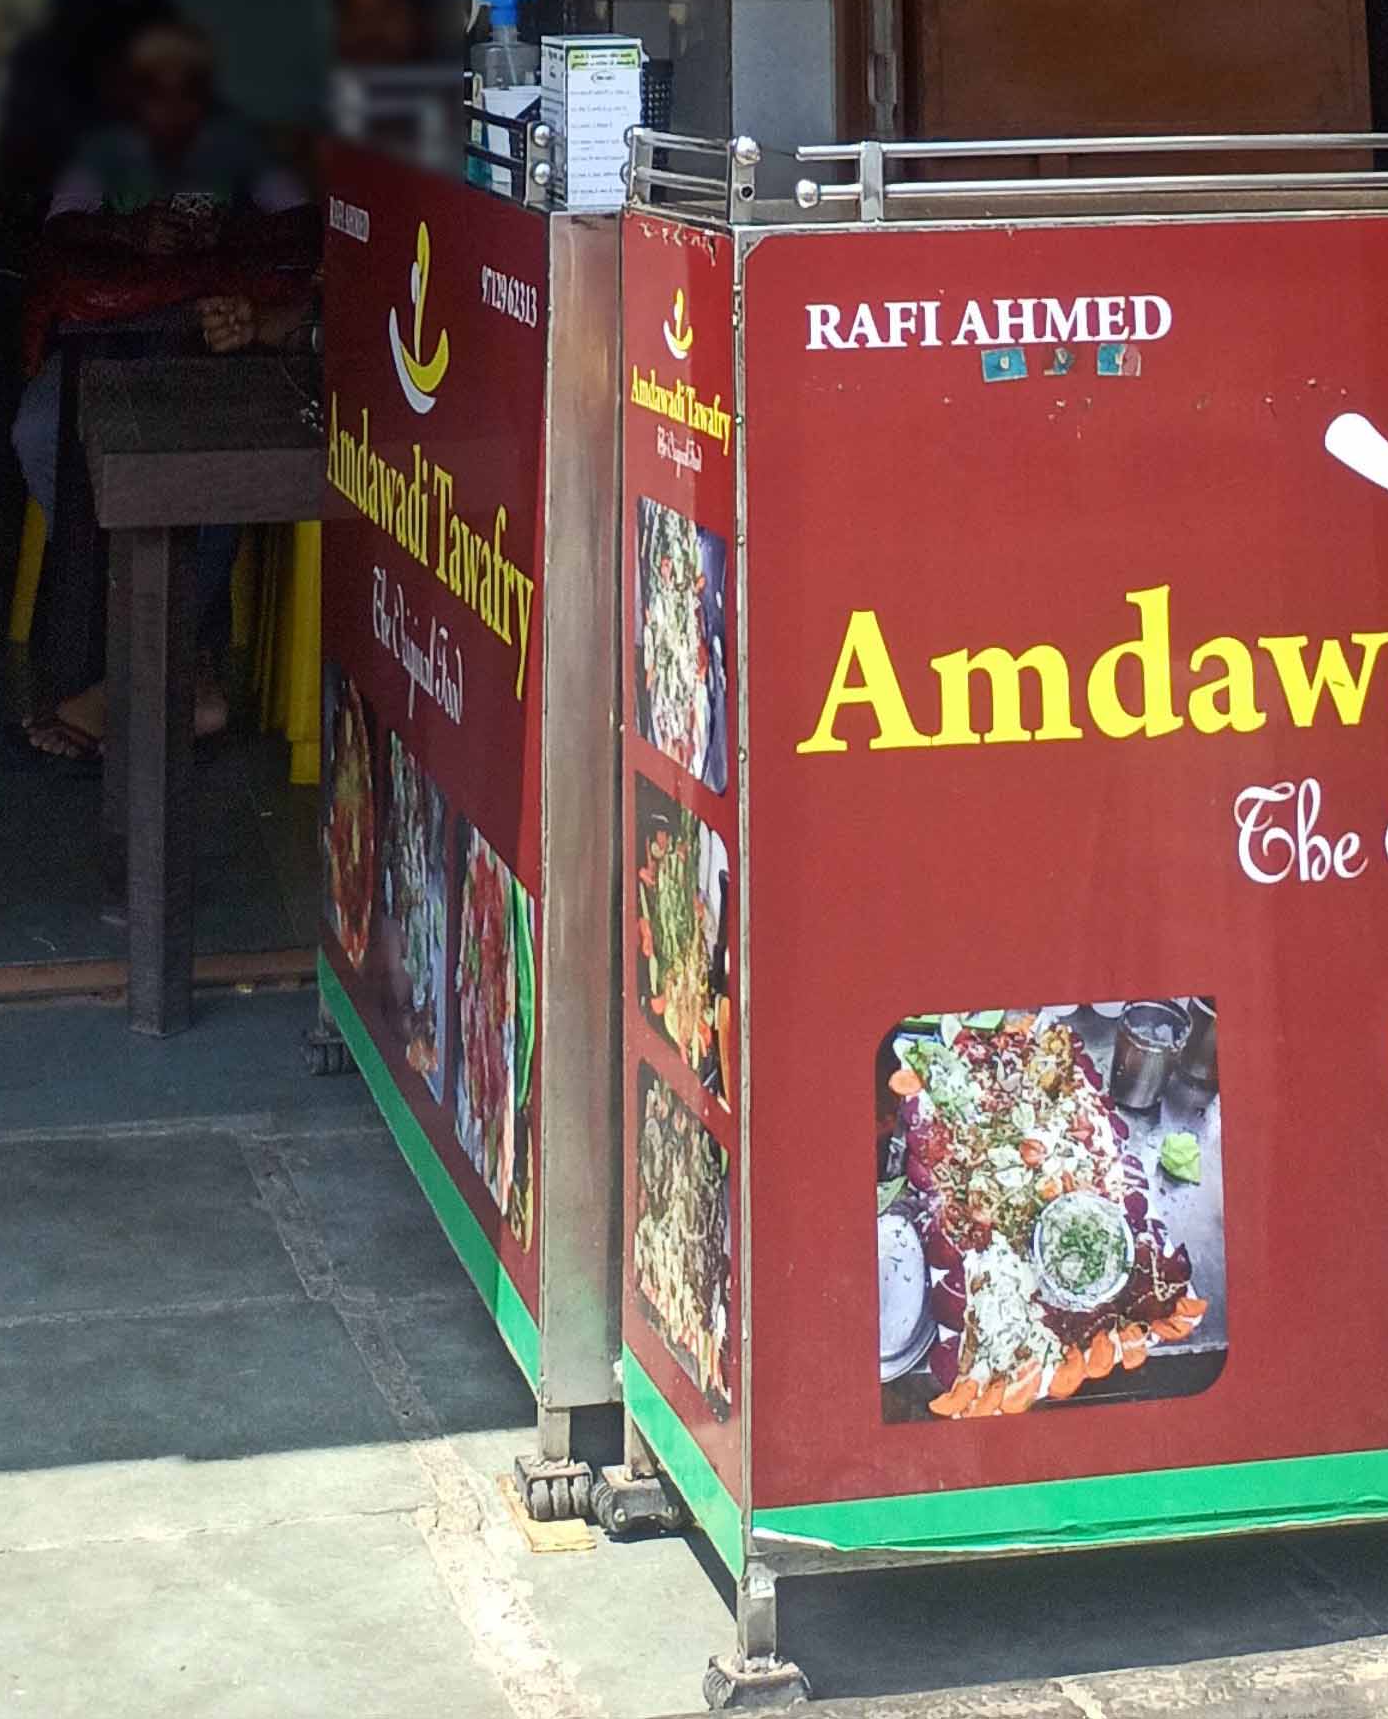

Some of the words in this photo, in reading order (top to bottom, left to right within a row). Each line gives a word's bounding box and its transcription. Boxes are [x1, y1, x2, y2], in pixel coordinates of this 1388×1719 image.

[805, 300, 943, 351] RAFI
[951, 294, 1173, 346] AHMED
[327, 391, 429, 567] Amdawadi
[433, 463, 534, 701] Tawafry
[1232, 777, 1368, 886] The
